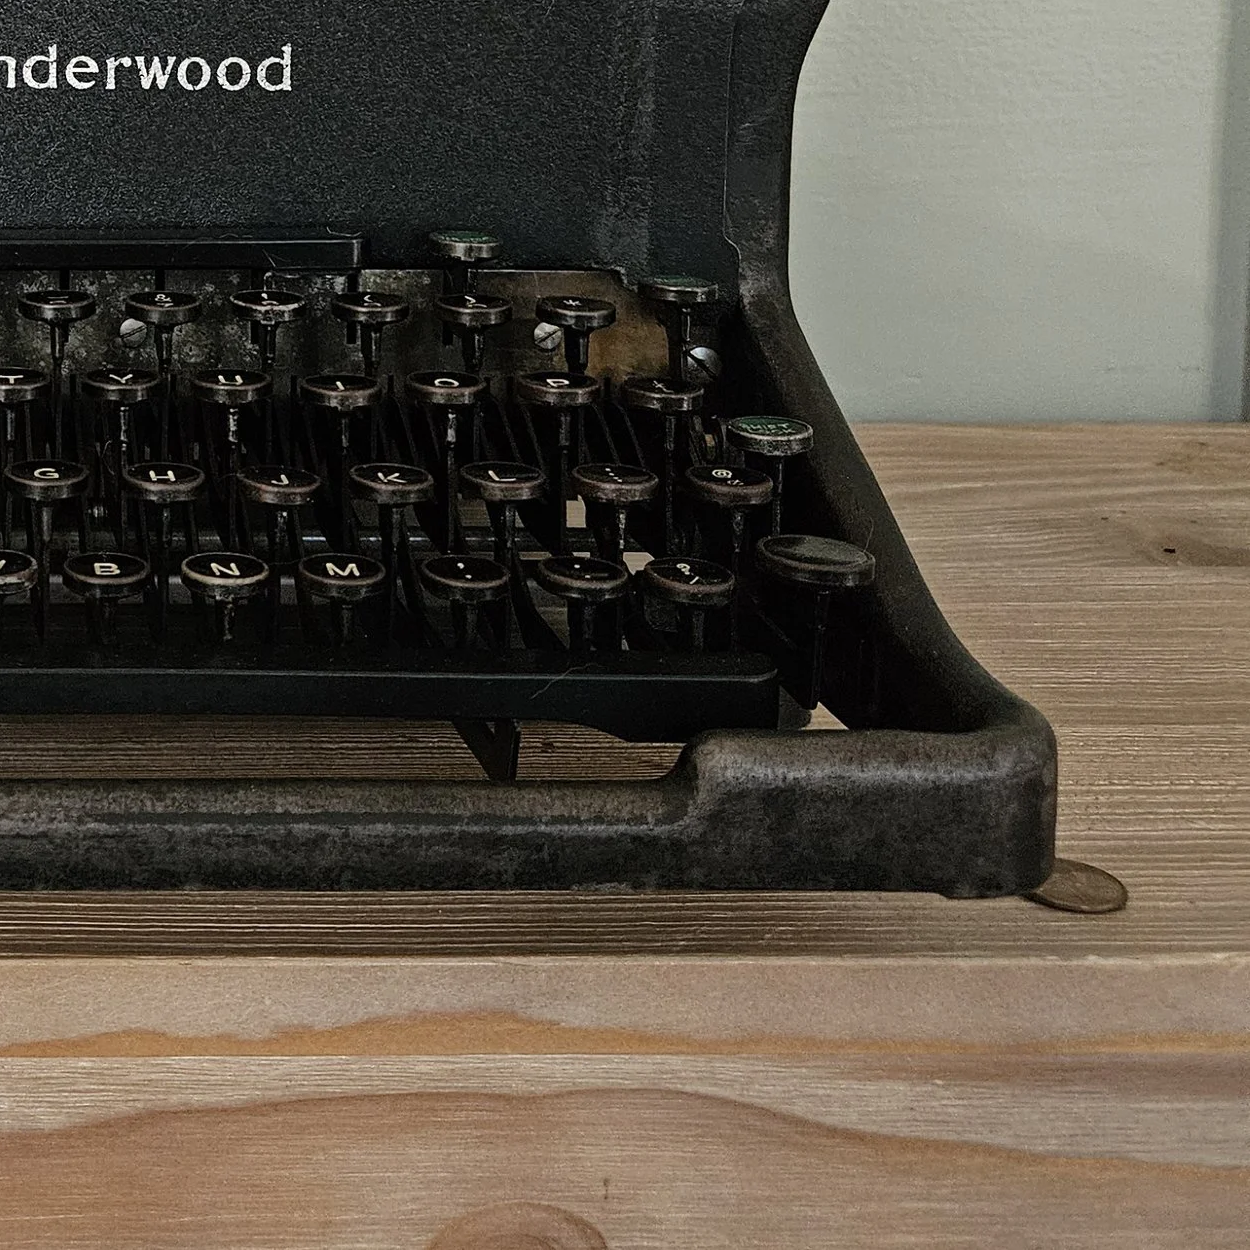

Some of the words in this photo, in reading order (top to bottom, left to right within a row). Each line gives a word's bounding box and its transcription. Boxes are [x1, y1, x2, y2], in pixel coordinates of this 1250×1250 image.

[109, 374, 134, 384] Y
[218, 375, 243, 386] U
[33, 468, 59, 479] G
[148, 470, 176, 482] H
[270, 474, 289, 485] J
[377, 472, 407, 483] K
[487, 470, 516, 482] L
[93, 562, 121, 575] B
[210, 562, 240, 576] N
[325, 562, 361, 577] M
